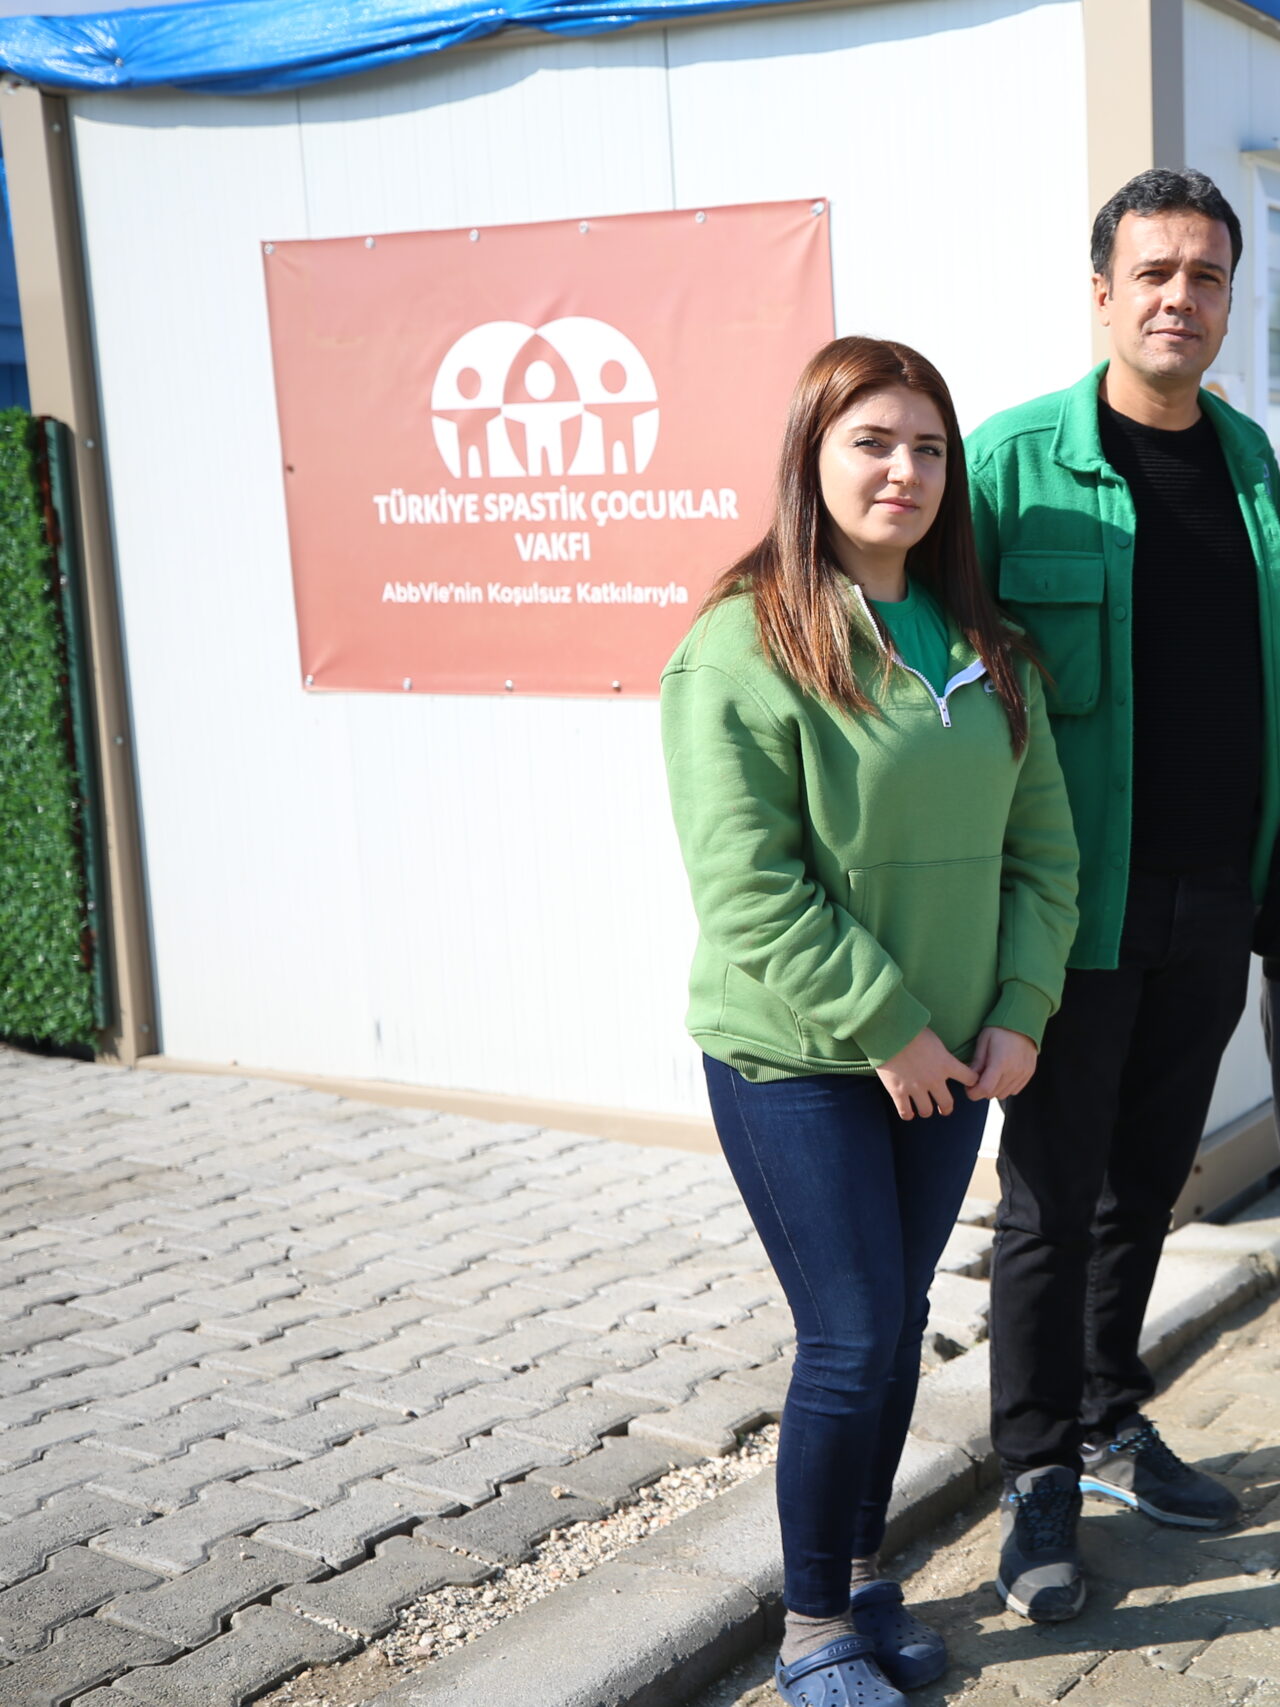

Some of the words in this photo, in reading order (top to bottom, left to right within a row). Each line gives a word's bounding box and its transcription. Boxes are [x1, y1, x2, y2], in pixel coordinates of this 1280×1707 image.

[373, 488, 480, 524] TÜRKİYE
[484, 485, 588, 521] SPASTİK
[591, 488, 739, 526] ÇOCUKLAR
[515, 532, 591, 561] VAKFI
[487, 582, 572, 606] Koşulsuz
[577, 582, 689, 607] Katkılarıyla
